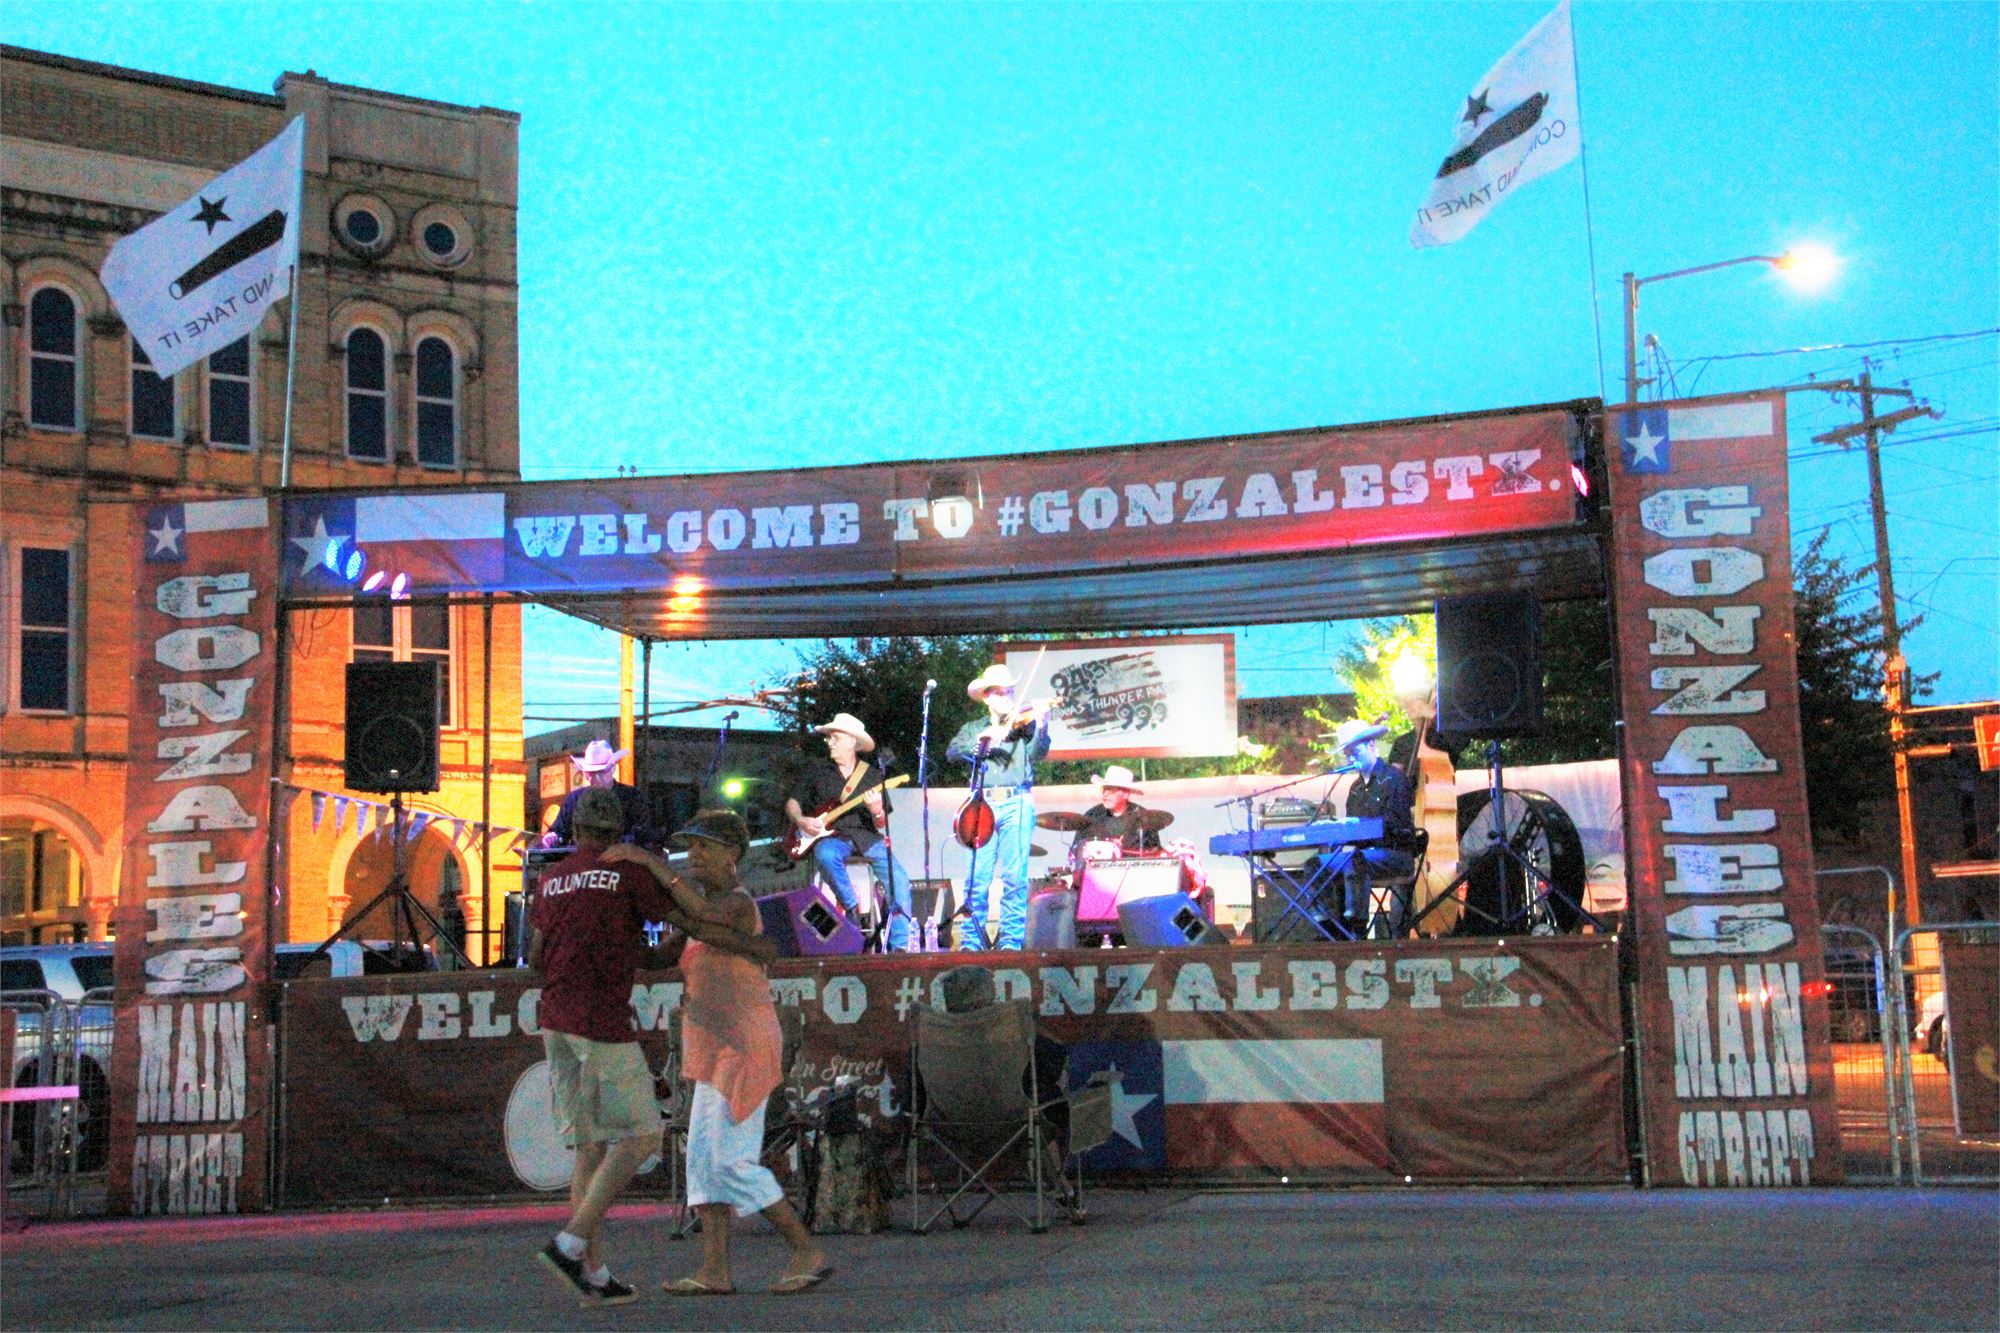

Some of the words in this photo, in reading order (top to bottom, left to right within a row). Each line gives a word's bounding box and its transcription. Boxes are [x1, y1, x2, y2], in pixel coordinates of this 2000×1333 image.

[513, 503, 860, 558] WELCOME
[884, 495, 974, 541] TO
[997, 449, 1562, 537] #GONZALESTX.
[1087, 689, 1145, 712] THUNDER
[1640, 486, 1794, 955] GONZALES
[145, 573, 261, 994] GONZALES
[543, 870, 621, 897] VOLUNTEER
[136, 1001, 246, 1123] MAIN
[821, 1055, 884, 1081] Street
[1667, 962, 1807, 1097] MAIN
[1678, 1109, 1814, 1187] STREET
